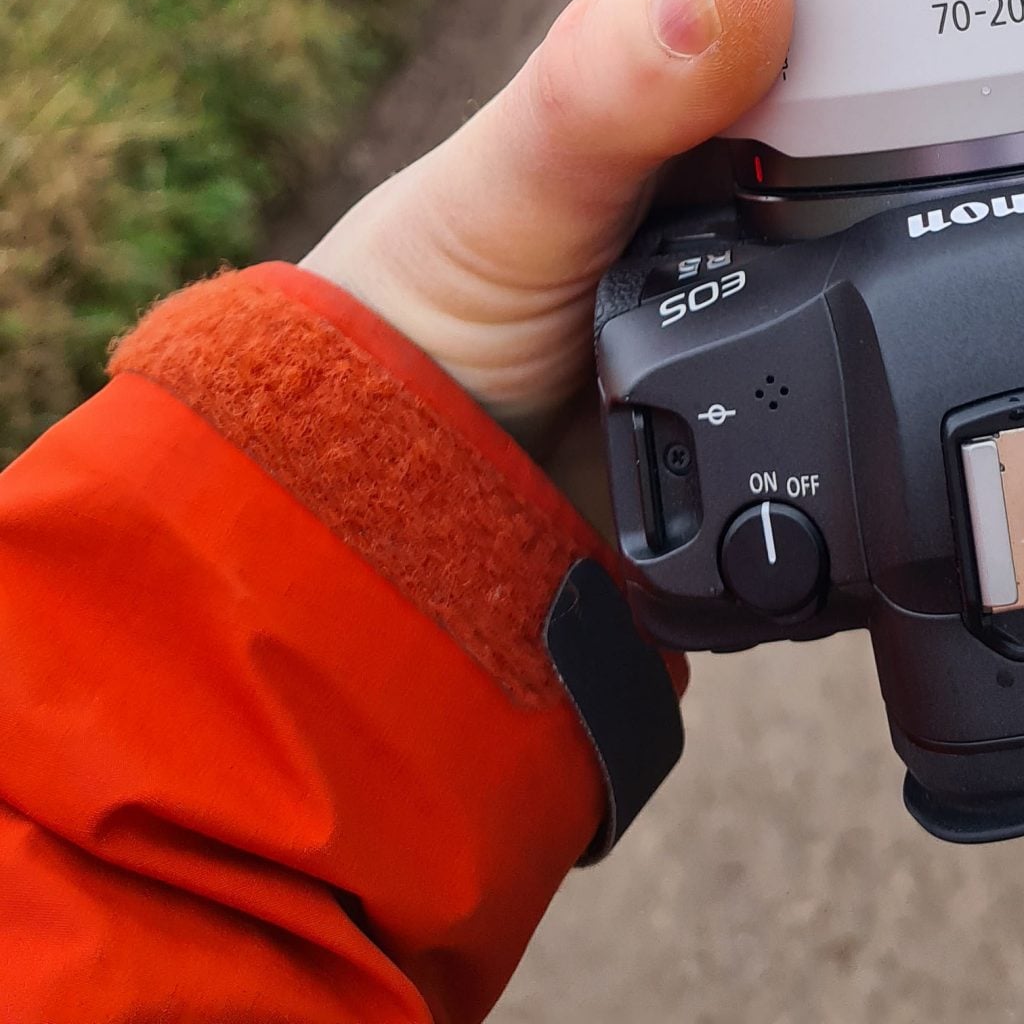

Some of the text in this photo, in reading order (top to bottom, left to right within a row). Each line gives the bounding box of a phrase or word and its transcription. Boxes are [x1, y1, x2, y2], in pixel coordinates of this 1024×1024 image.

[659, 270, 746, 328] EOS
[749, 471, 820, 498] ON OFF
